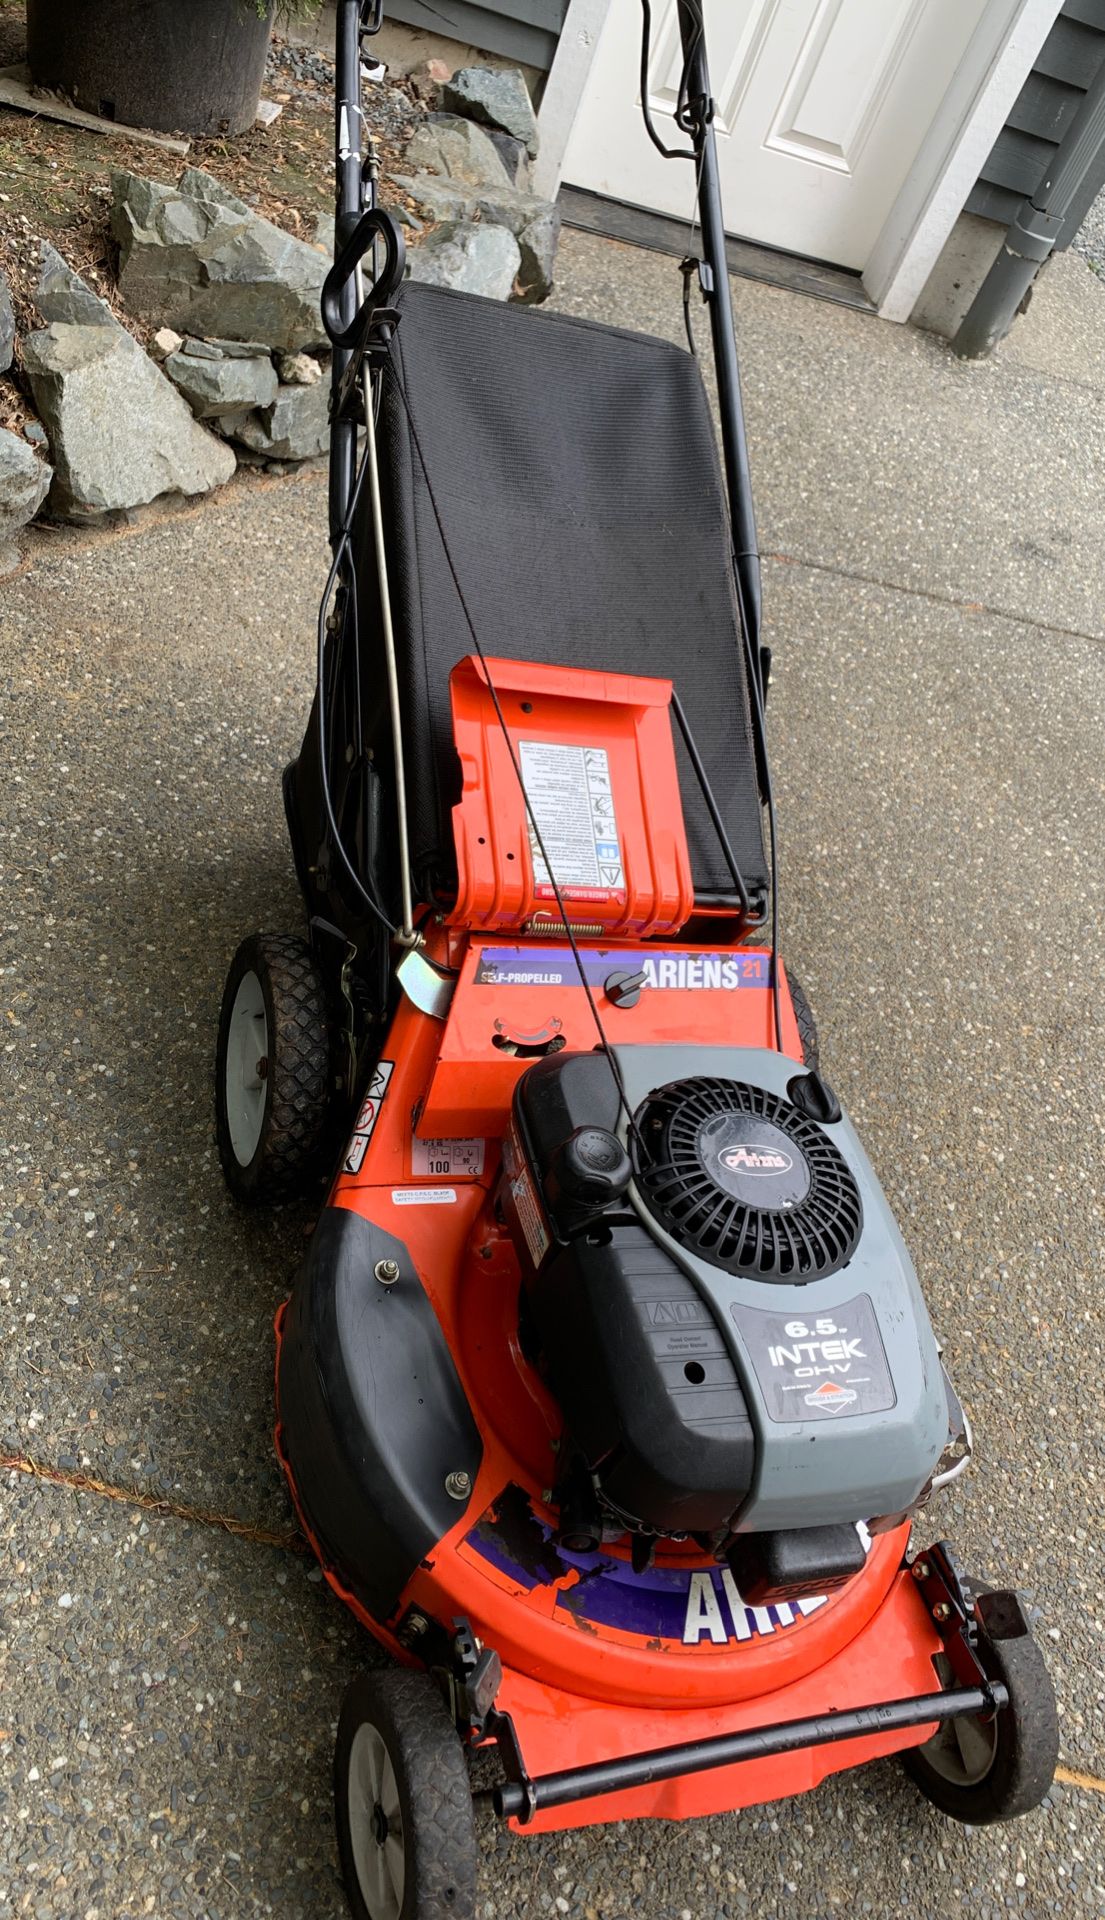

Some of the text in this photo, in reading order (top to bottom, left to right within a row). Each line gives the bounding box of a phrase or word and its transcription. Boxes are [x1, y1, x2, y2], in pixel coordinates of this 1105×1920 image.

[640, 959, 761, 989] ARIENS 21
[429, 1160, 450, 1174] 100
[468, 1166, 479, 1175] CE
[784, 1318, 838, 1338] 6.5
[768, 1338, 867, 1367] INTEK
[794, 1362, 851, 1378] OHV
